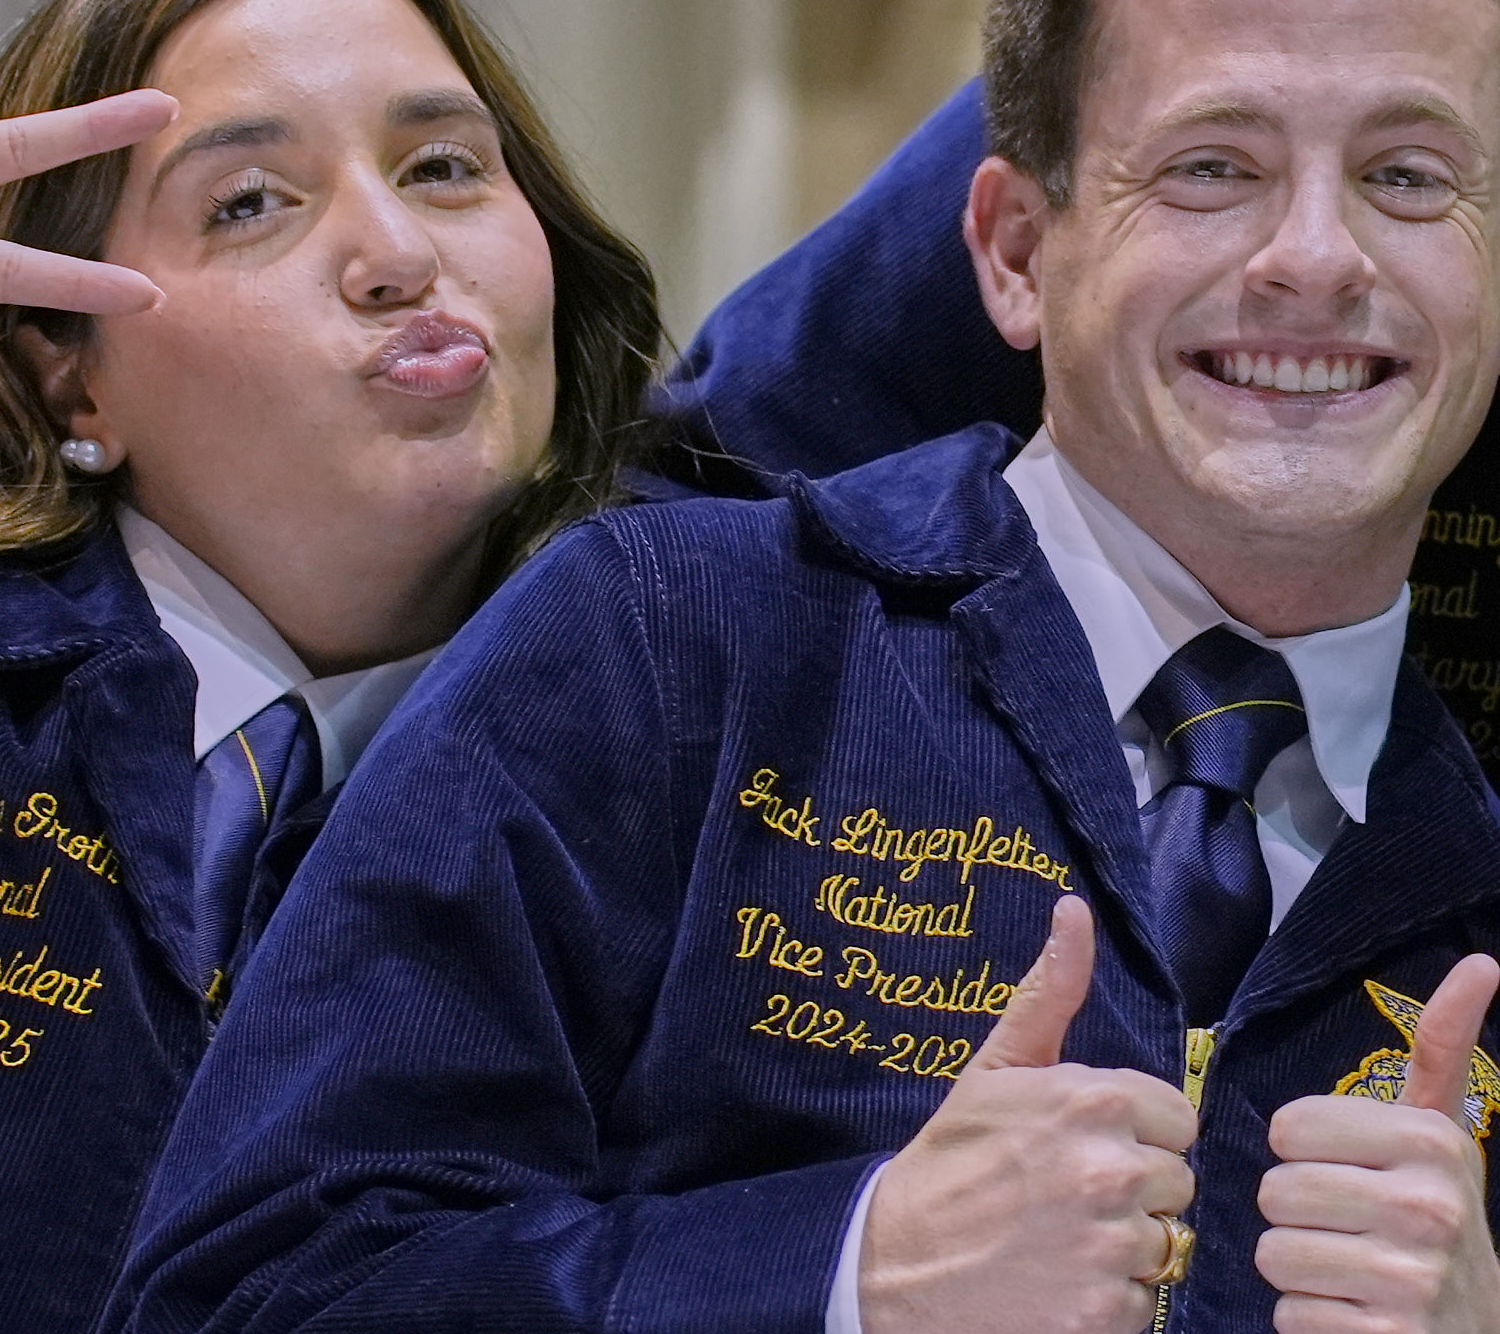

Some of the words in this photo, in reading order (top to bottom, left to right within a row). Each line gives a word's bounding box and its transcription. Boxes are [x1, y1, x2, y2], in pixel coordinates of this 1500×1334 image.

[738, 768, 822, 847] Jack
[831, 808, 1075, 893] Lingenfelter
[813, 874, 975, 938] National
[735, 907, 825, 977] Vice
[834, 945, 1021, 1016] Preside
[751, 993, 973, 1082] 2024-202
